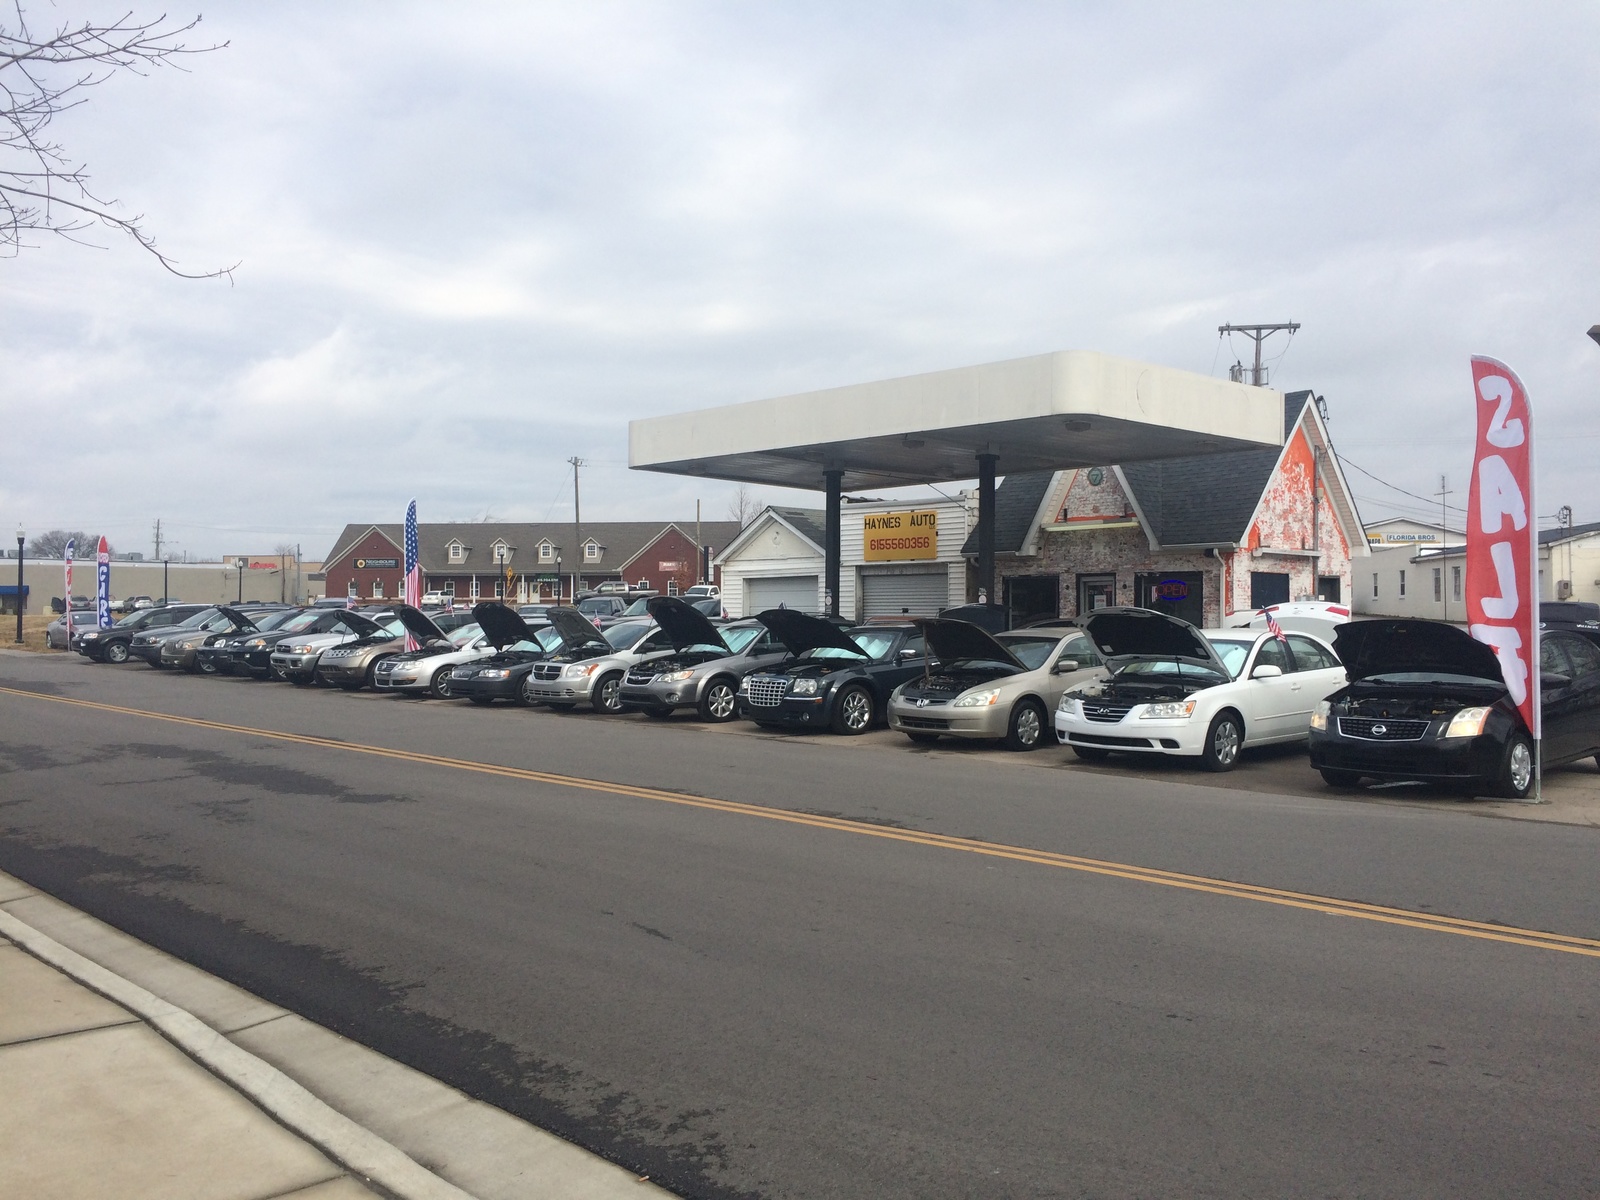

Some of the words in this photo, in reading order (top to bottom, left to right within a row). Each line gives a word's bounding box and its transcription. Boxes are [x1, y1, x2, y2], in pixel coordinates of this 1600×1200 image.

[864, 516, 901, 530] HAYNES
[910, 514, 936, 527] AUTO
[870, 537, 930, 550] 6155560356
[1156, 584, 1188, 596] OPEN
